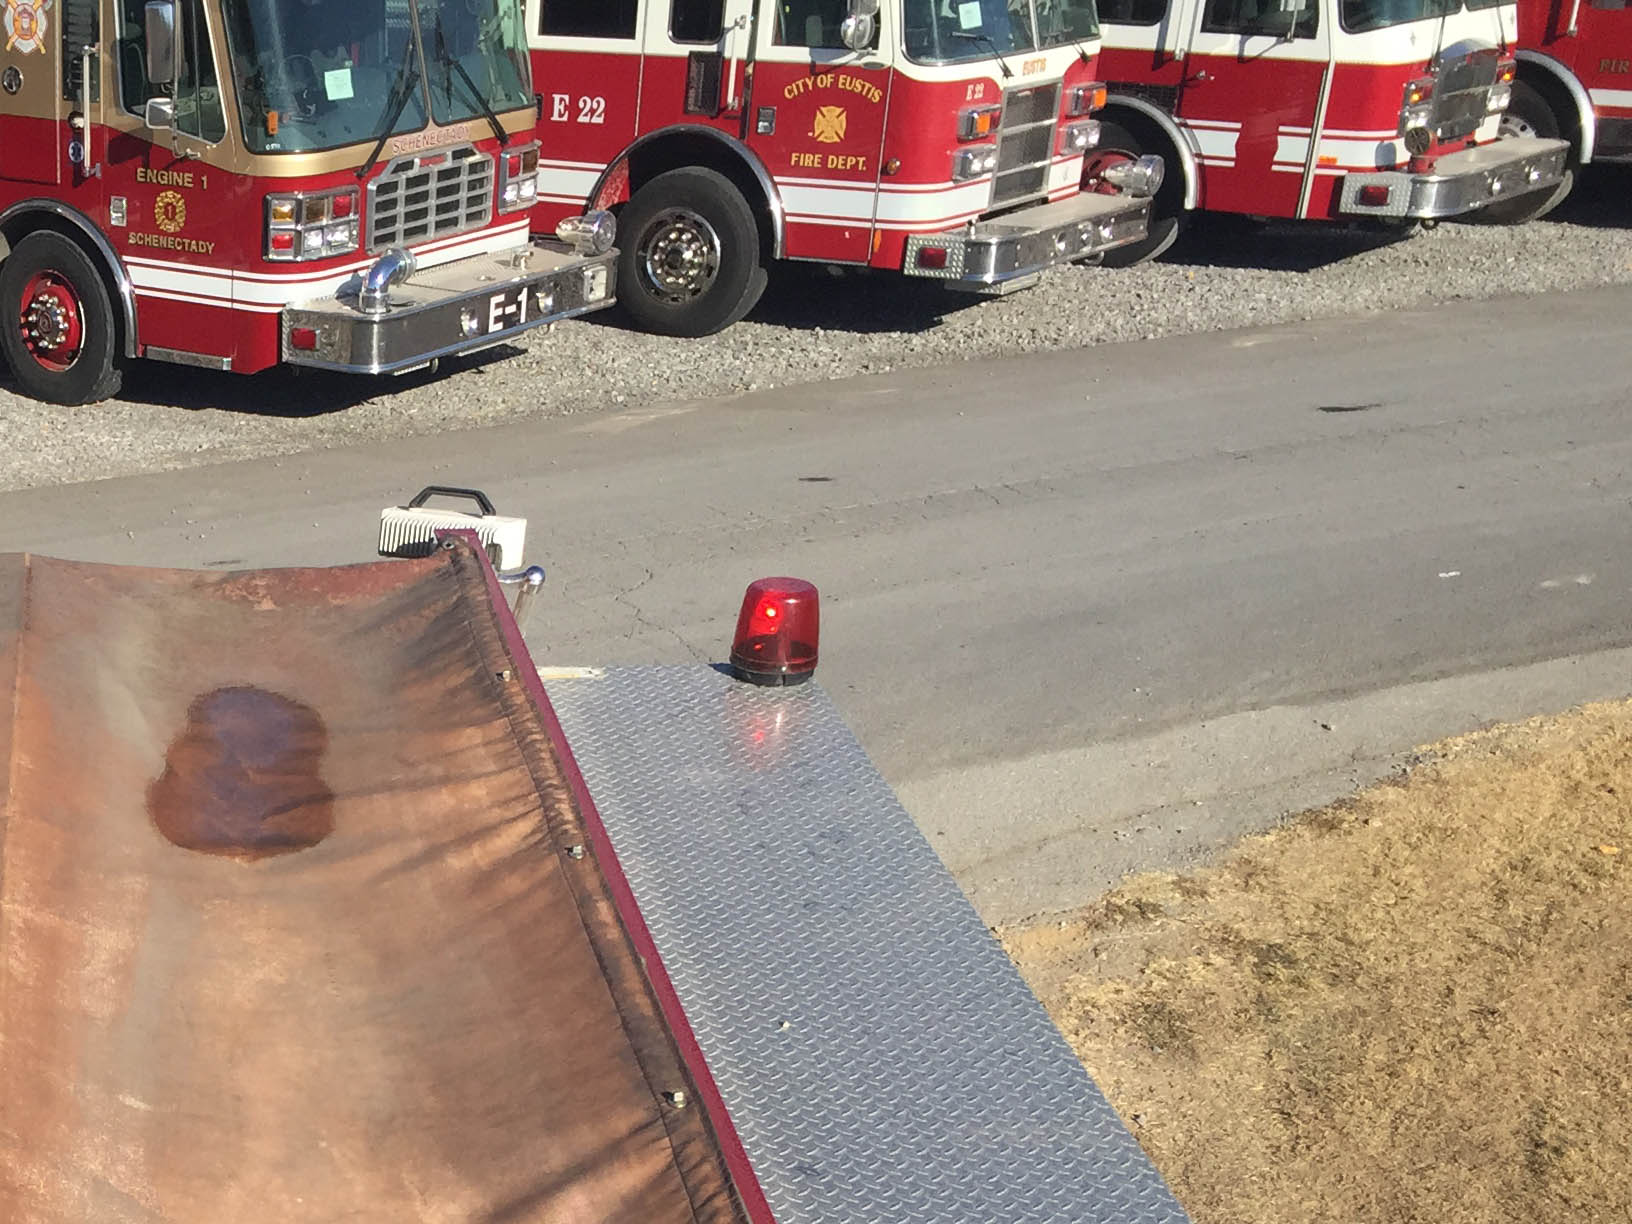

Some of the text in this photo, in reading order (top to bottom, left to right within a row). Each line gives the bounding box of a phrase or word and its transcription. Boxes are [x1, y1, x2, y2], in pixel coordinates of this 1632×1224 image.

[784, 73, 882, 103] CITY OF EUSTIS
[550, 93, 606, 124] E 22
[790, 152, 867, 171] FIRE DEPT.
[136, 167, 208, 190] ENGINE 1
[128, 231, 216, 254] SCHENECTADY
[488, 287, 528, 334] E-1
